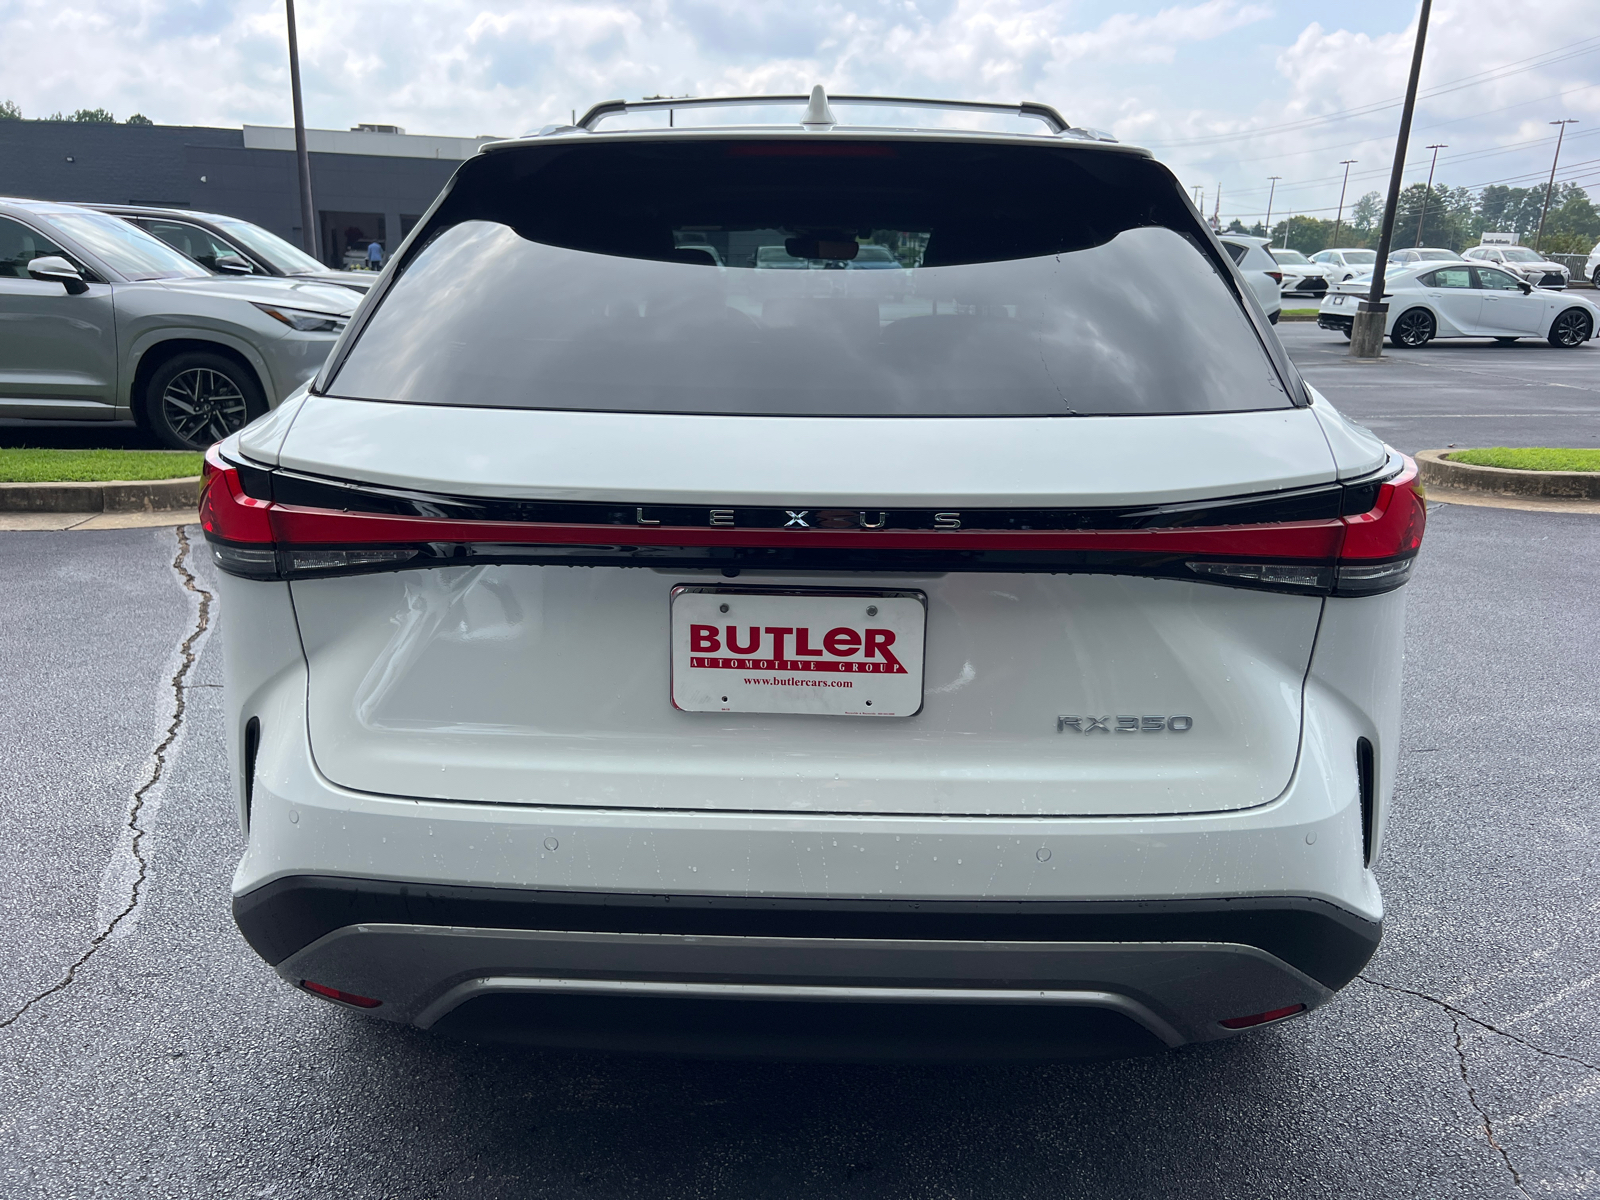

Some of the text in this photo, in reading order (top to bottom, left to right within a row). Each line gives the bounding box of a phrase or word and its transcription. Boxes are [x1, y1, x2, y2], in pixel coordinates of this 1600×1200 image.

[636, 507, 961, 529] LEXUS
[691, 659, 901, 673] AUTOMOTIVE GROUP
[743, 677, 853, 688] www.butlercars.com
[1056, 714, 1193, 734] RX350
